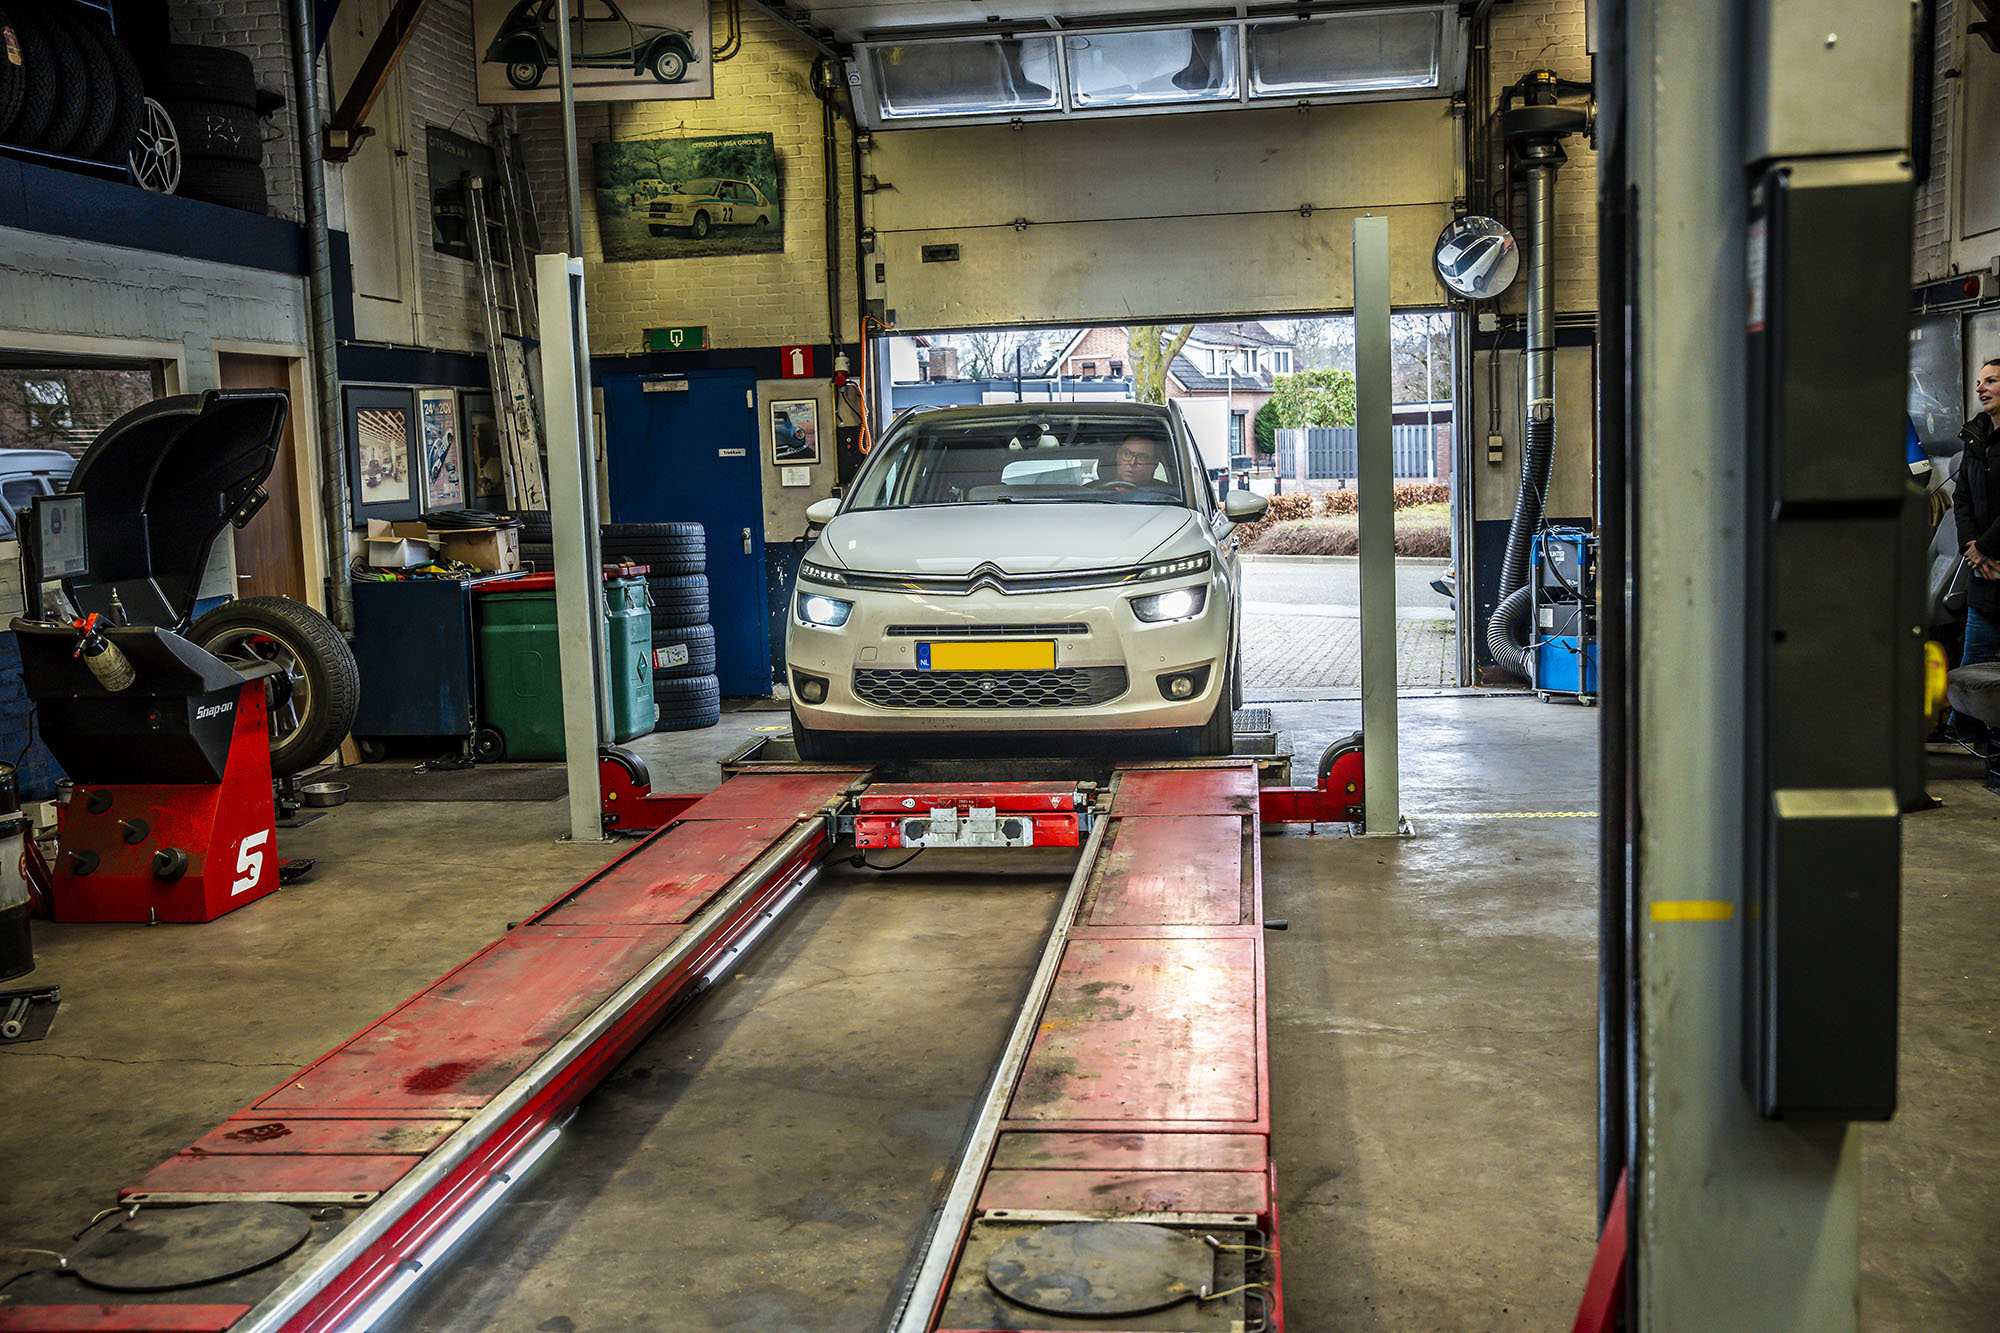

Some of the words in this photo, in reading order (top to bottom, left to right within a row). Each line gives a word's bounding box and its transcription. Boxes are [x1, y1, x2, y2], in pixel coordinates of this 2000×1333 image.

[737, 138, 763, 146] GROUPE
[722, 207, 734, 222] 22
[196, 701, 233, 720] Snap-on
